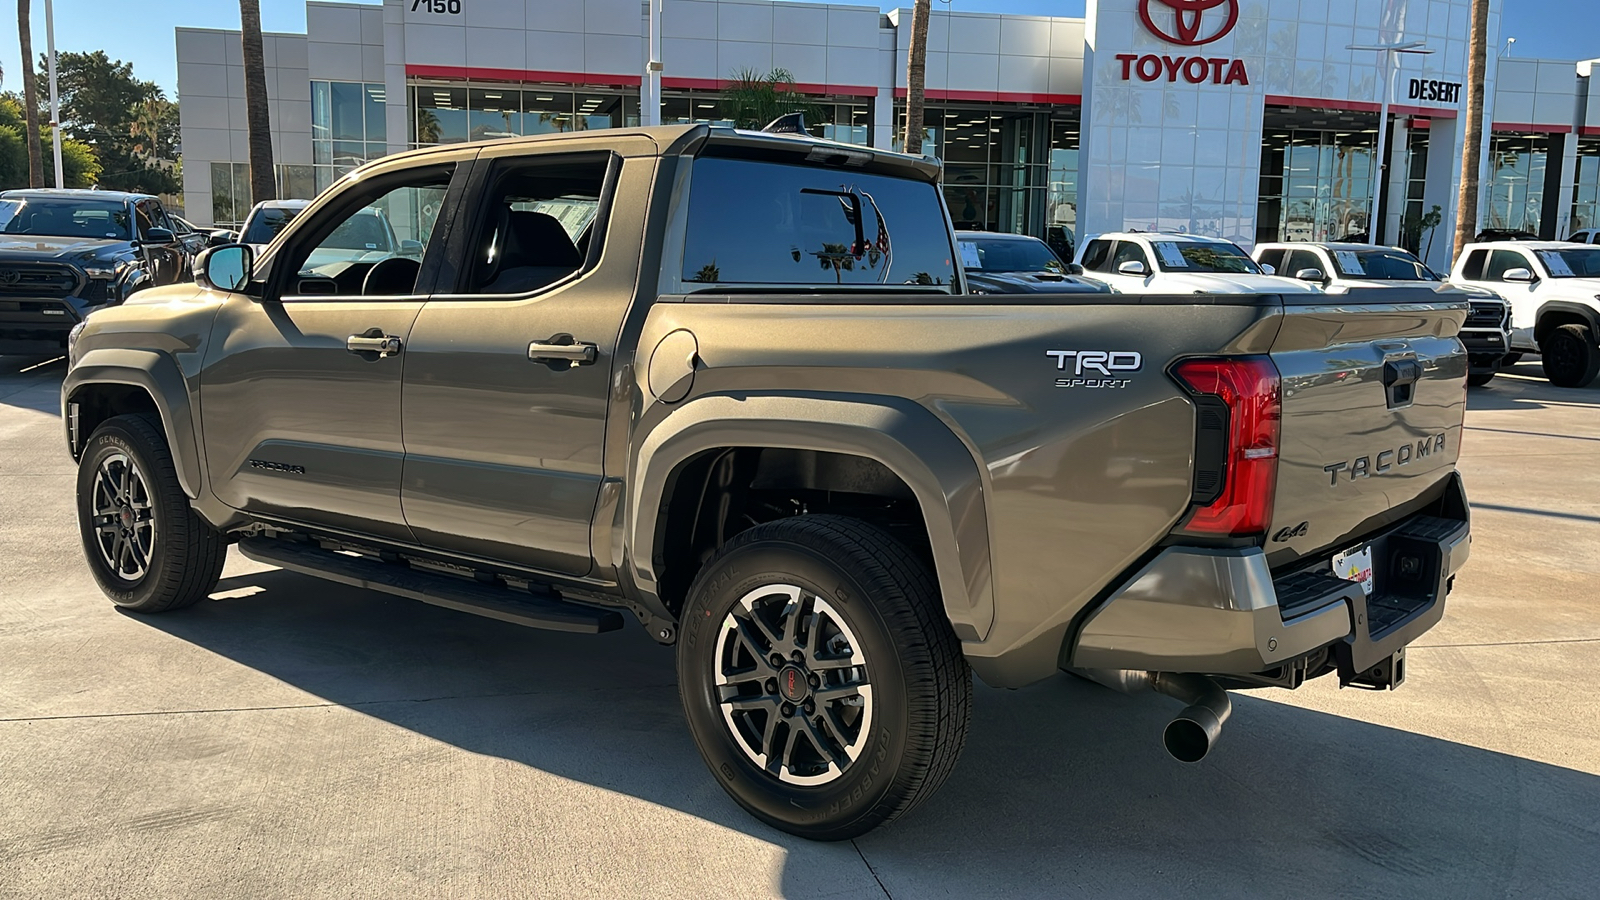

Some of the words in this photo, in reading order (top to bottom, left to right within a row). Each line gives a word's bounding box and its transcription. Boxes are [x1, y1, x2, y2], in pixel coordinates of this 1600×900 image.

[411, 0, 461, 14] 7150
[1115, 54, 1249, 85] TOYOTA
[1408, 78, 1462, 103] DESERT
[1046, 350, 1141, 375] TRD
[1054, 379, 1131, 389] SPORT
[1323, 432, 1446, 487] TACOMA
[687, 564, 740, 649] GENERAL
[829, 726, 891, 816] GRABBER
